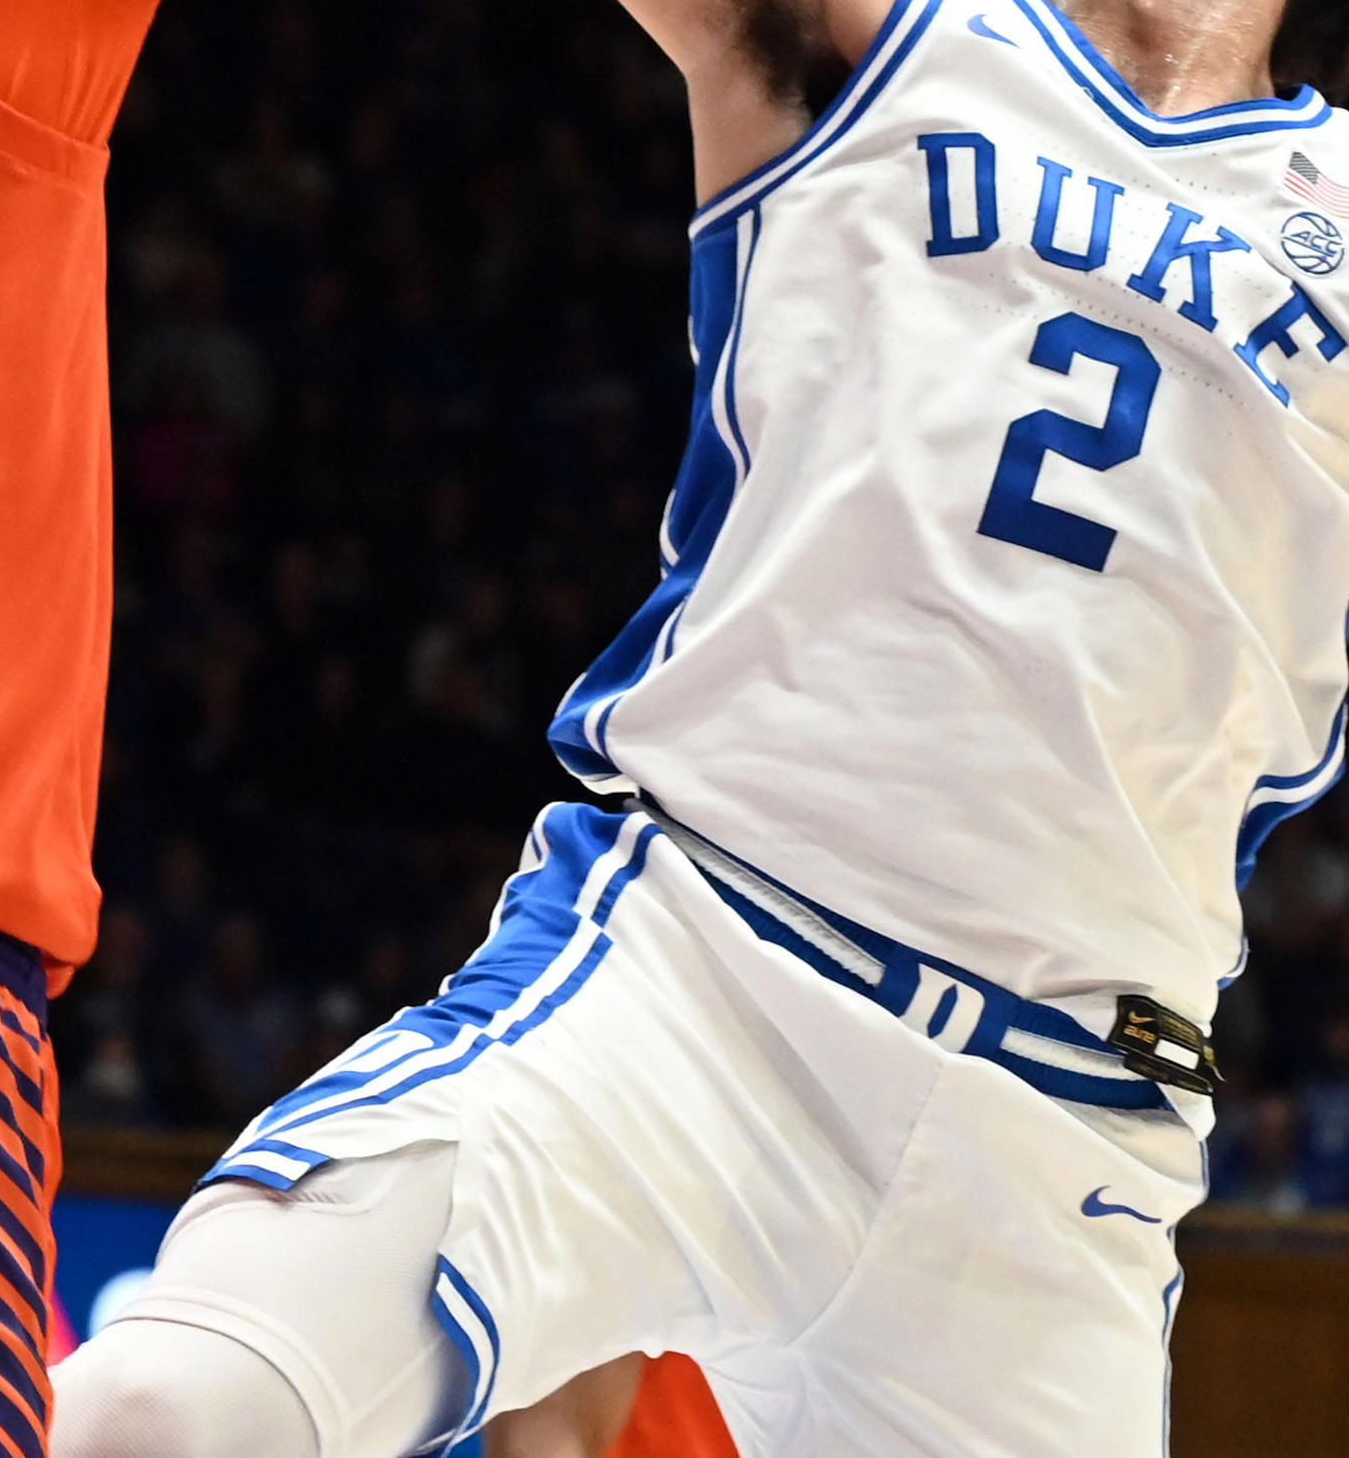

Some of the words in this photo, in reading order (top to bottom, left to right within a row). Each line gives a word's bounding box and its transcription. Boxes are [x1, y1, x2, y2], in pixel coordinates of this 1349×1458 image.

[917, 131, 1349, 407] DUKE
[1289, 230, 1343, 255] ACC
[977, 311, 1162, 572] 2
